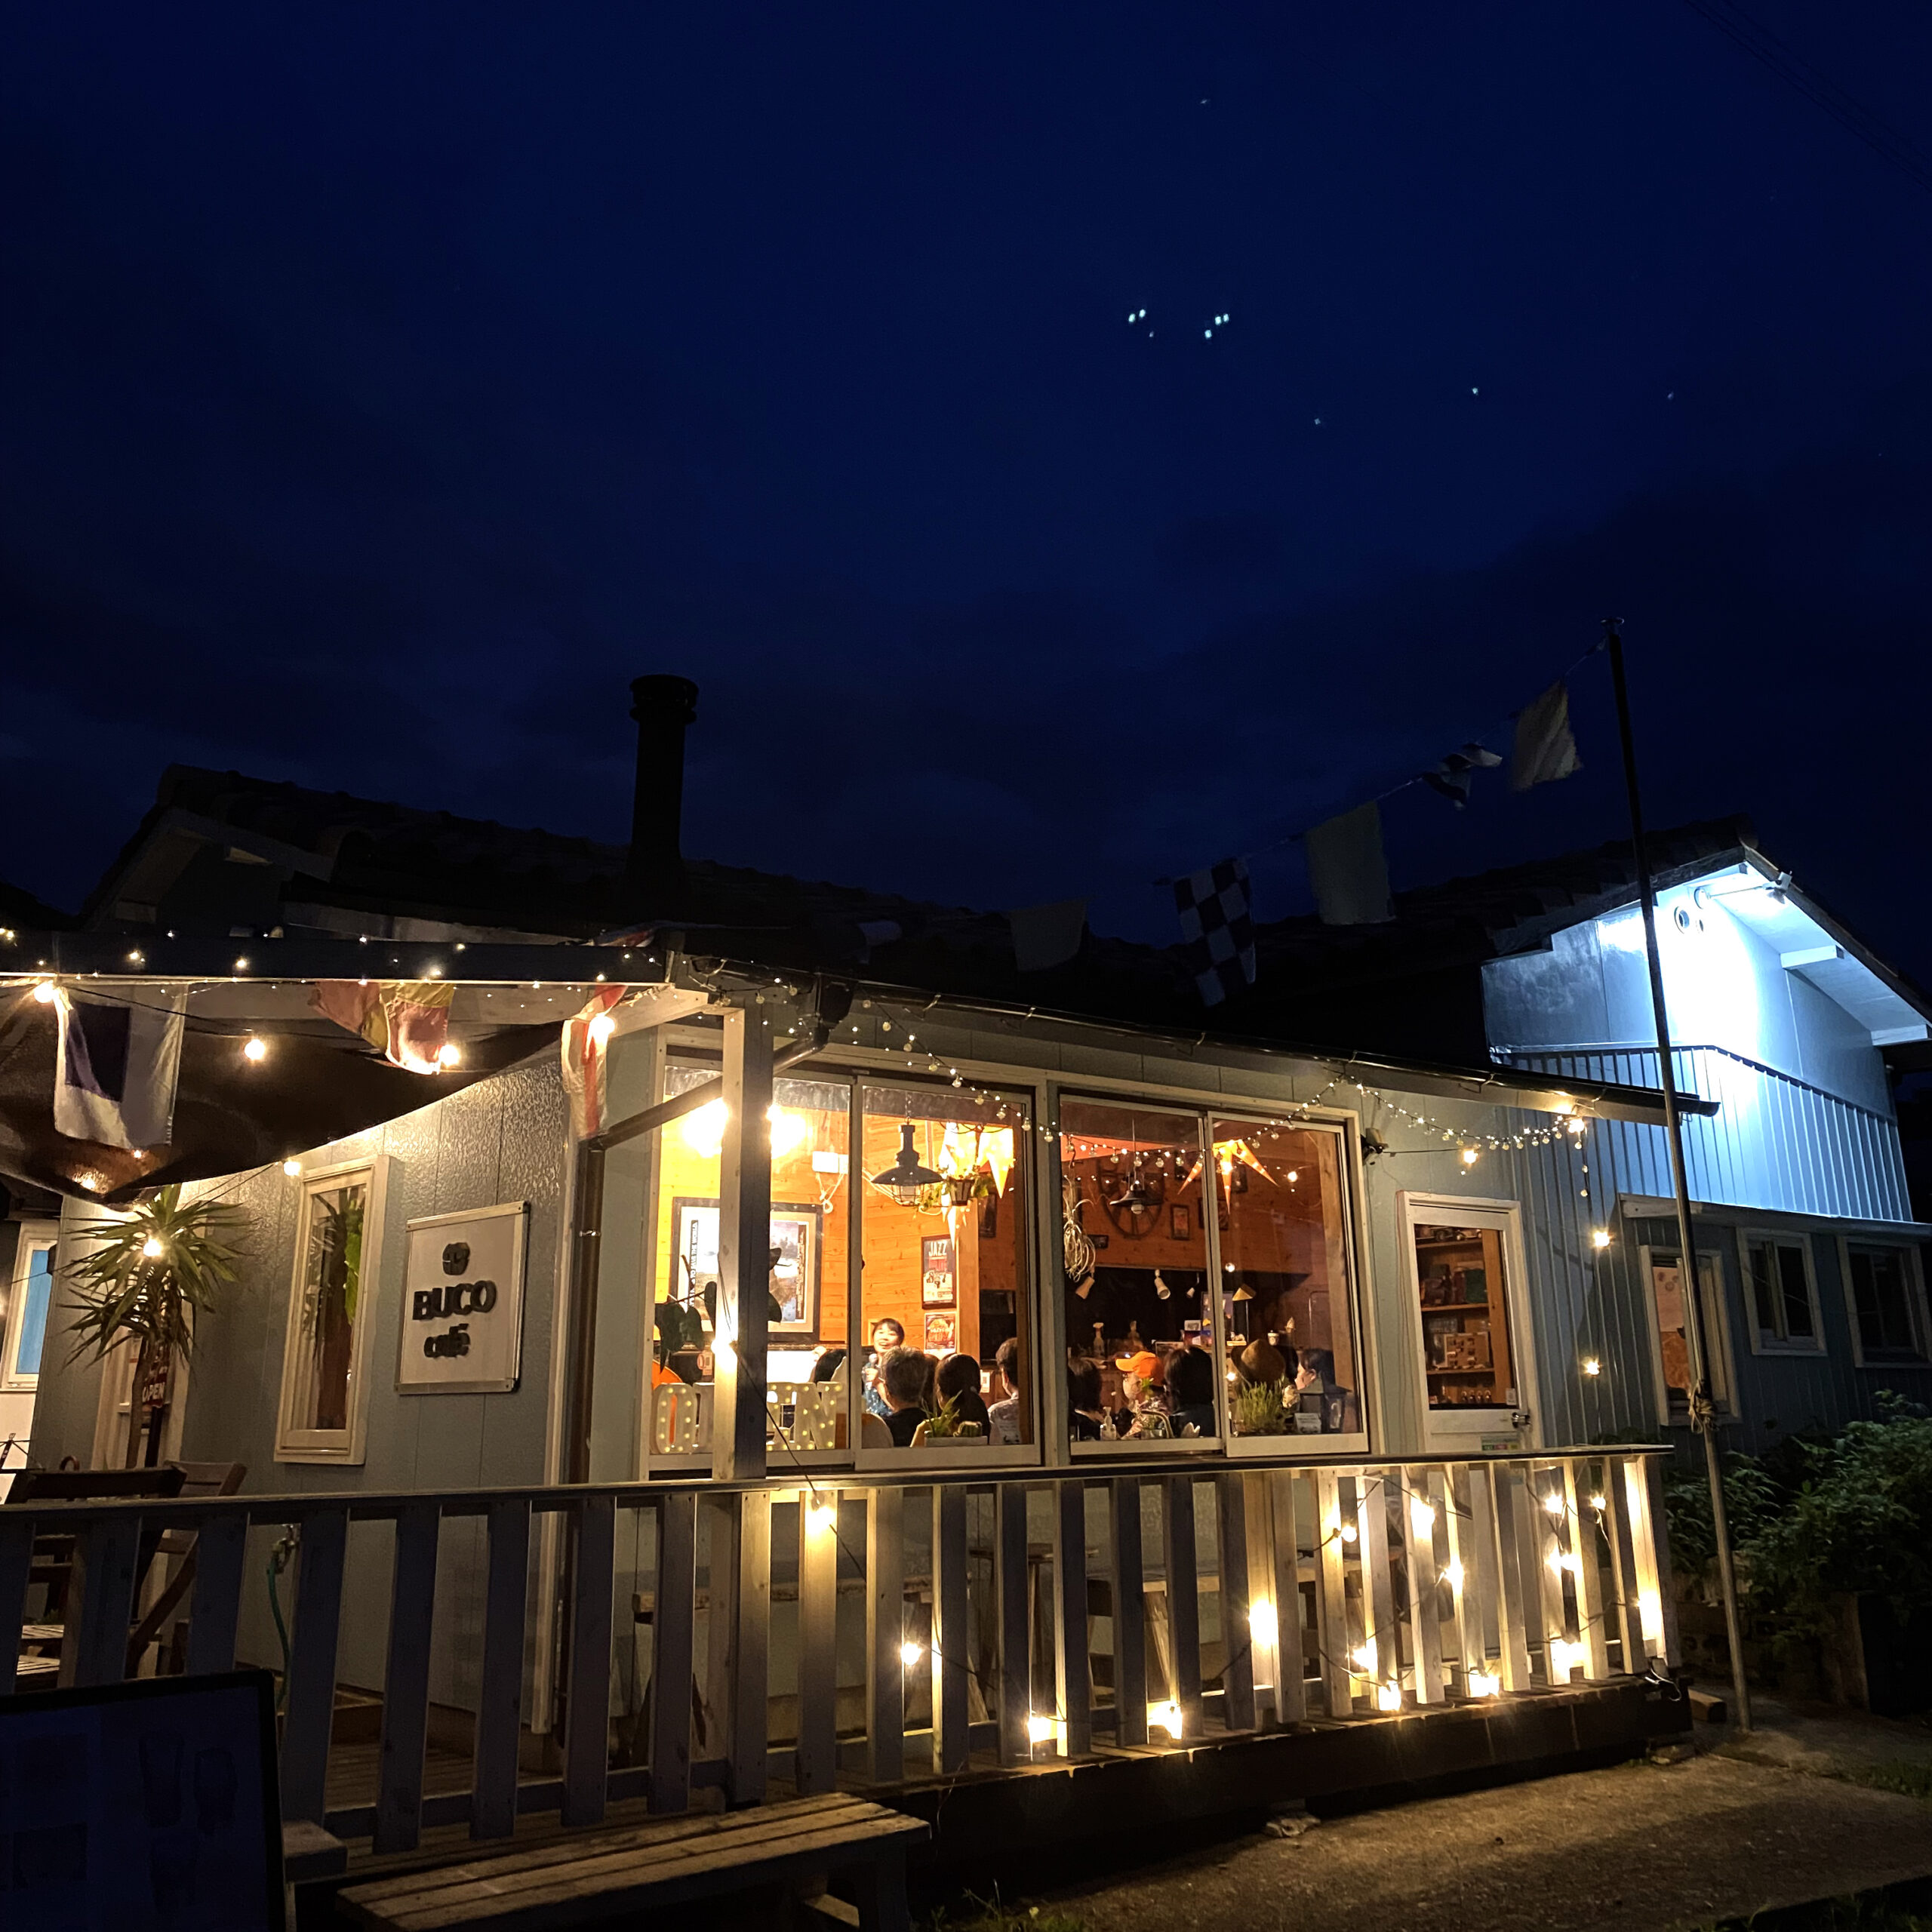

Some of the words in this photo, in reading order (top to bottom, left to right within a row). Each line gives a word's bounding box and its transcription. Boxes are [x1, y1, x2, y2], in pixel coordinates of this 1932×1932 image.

[928, 1240, 948, 1257] JAZZ
[413, 1281, 497, 1320] BUCO
[141, 1382, 165, 1401] OPEN
